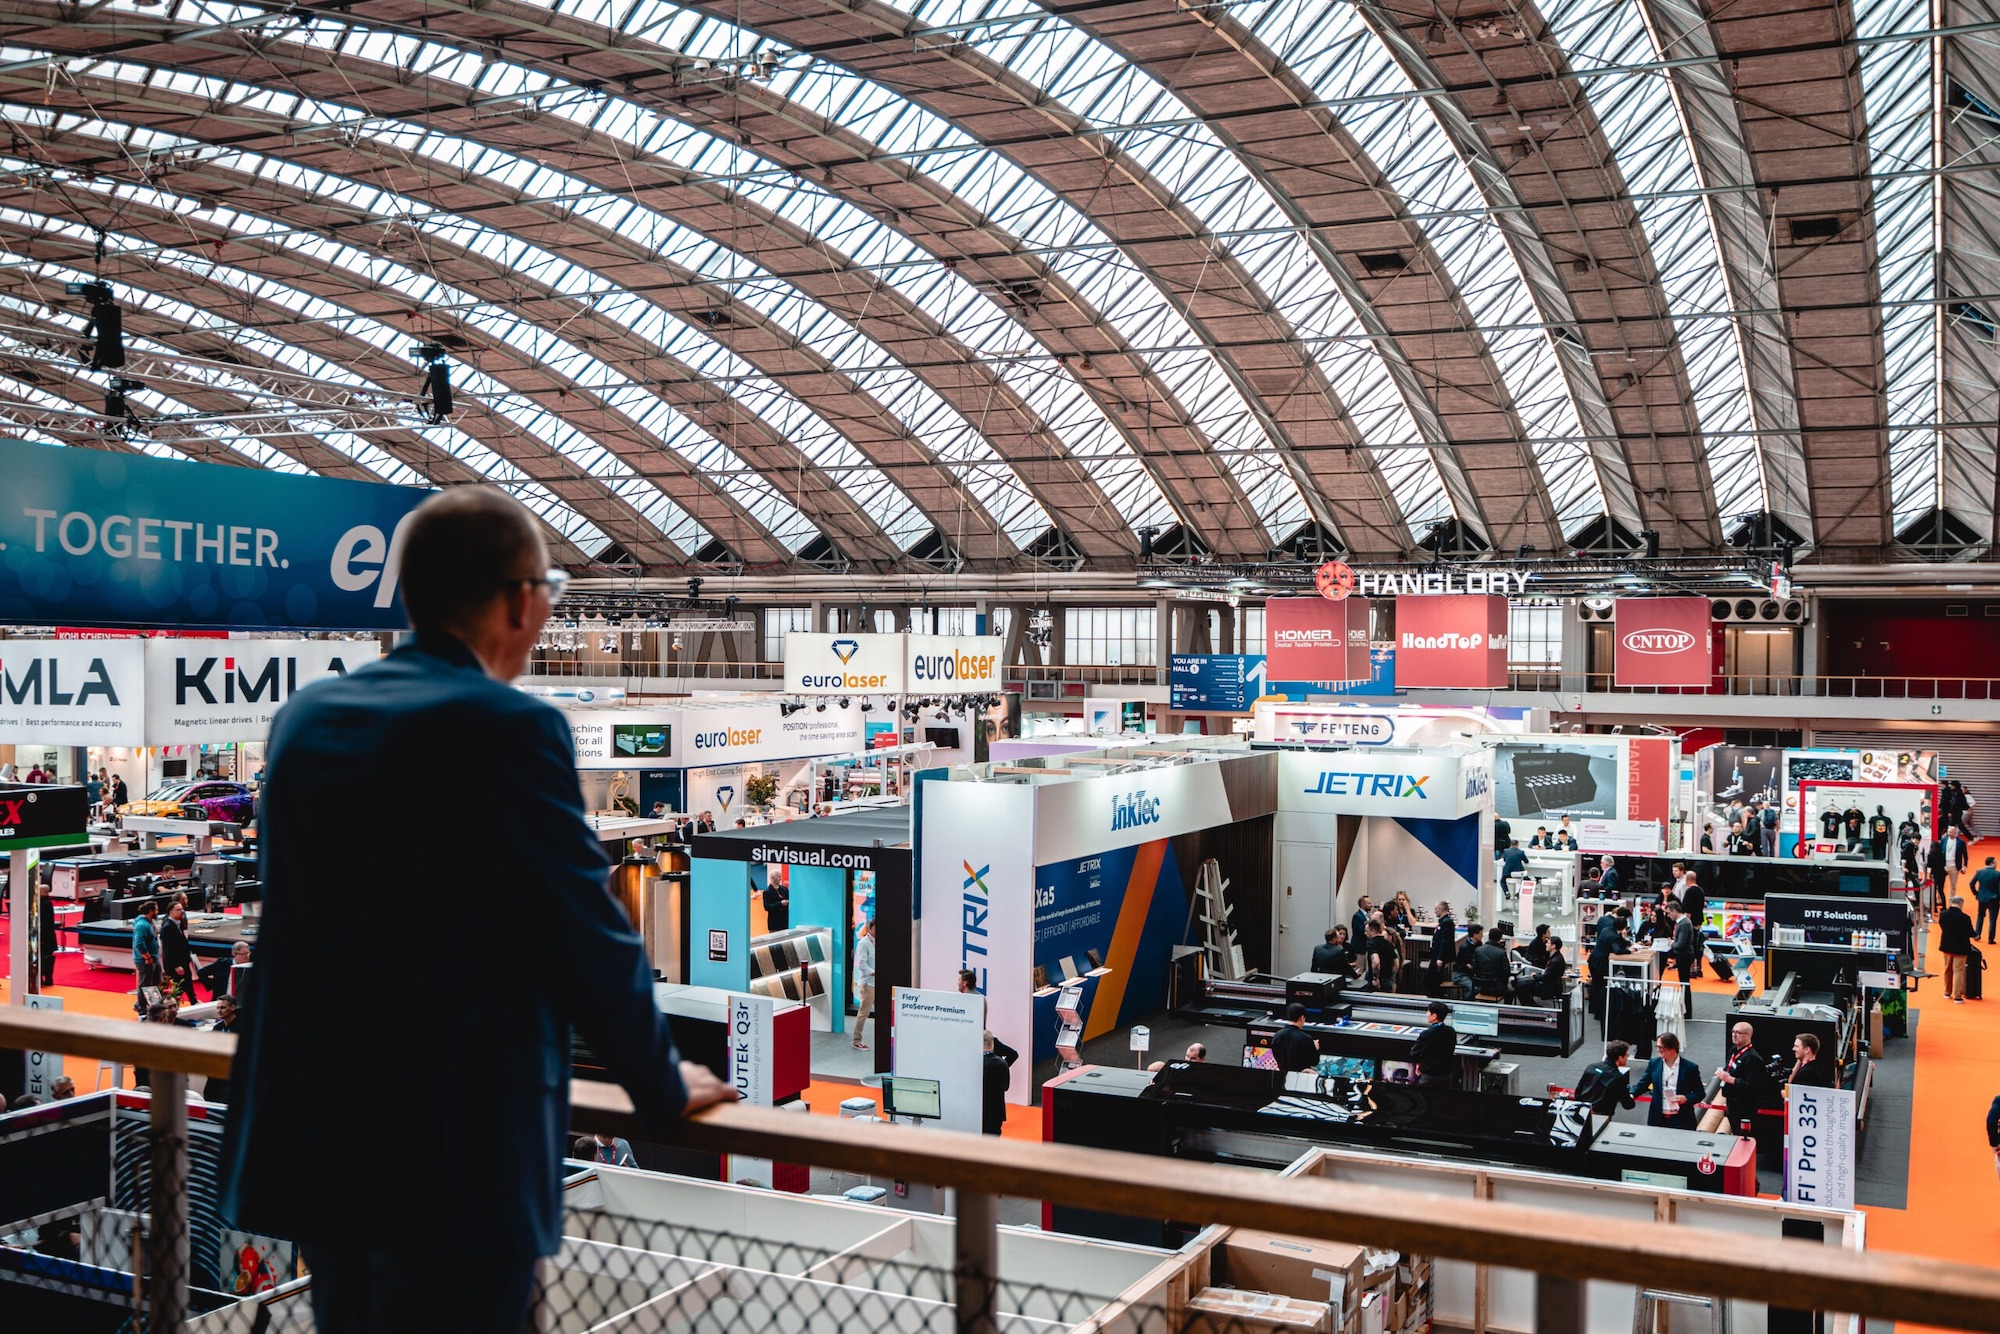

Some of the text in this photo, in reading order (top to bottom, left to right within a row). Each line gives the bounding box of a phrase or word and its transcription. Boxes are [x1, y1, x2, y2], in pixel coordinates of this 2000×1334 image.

[23, 508, 289, 569] TOGETHER.
[1359, 571, 1531, 595] HANGLORY
[1275, 630, 1332, 639] HOMER
[1628, 634, 1690, 649] CNTOP
[914, 648, 996, 680] eurolaser
[802, 672, 887, 688] eurolaser
[26, 718, 40, 726] Best
[41, 718, 80, 727] performance
[81, 719, 93, 727] and
[94, 720, 122, 728] accuracy
[174, 718, 207, 727] Magnetic
[209, 717, 229, 725] linear
[231, 716, 253, 724] drives
[570, 724, 603, 733] achine
[575, 736, 603, 745] for all
[695, 727, 762, 749] eurolaser
[573, 748, 603, 757] ations
[692, 770, 703, 778] High
[1304, 771, 1430, 799] JETRIX
[1629, 739, 1640, 820] HANGLOR
[1111, 790, 1160, 831] InkTec
[752, 844, 871, 869] sirvisual.com
[1077, 858, 1101, 873] JETRIX
[1044, 922, 1069, 939] EFFICIENT
[1071, 912, 1101, 931] AFFORDABLE
[1804, 910, 1868, 921] DTF Solutions
[962, 859, 990, 997] ETRIX
[902, 993, 919, 1002] Fiery
[902, 1003, 966, 1015] proServer Premium
[736, 1002, 751, 1034] Q3r
[1798, 1093, 1817, 1129] 33r
[1798, 1135, 1817, 1172] Pro
[1837, 1097, 1849, 1199] and high-quality imaging
[1824, 1148, 1833, 1208] oduction-level
